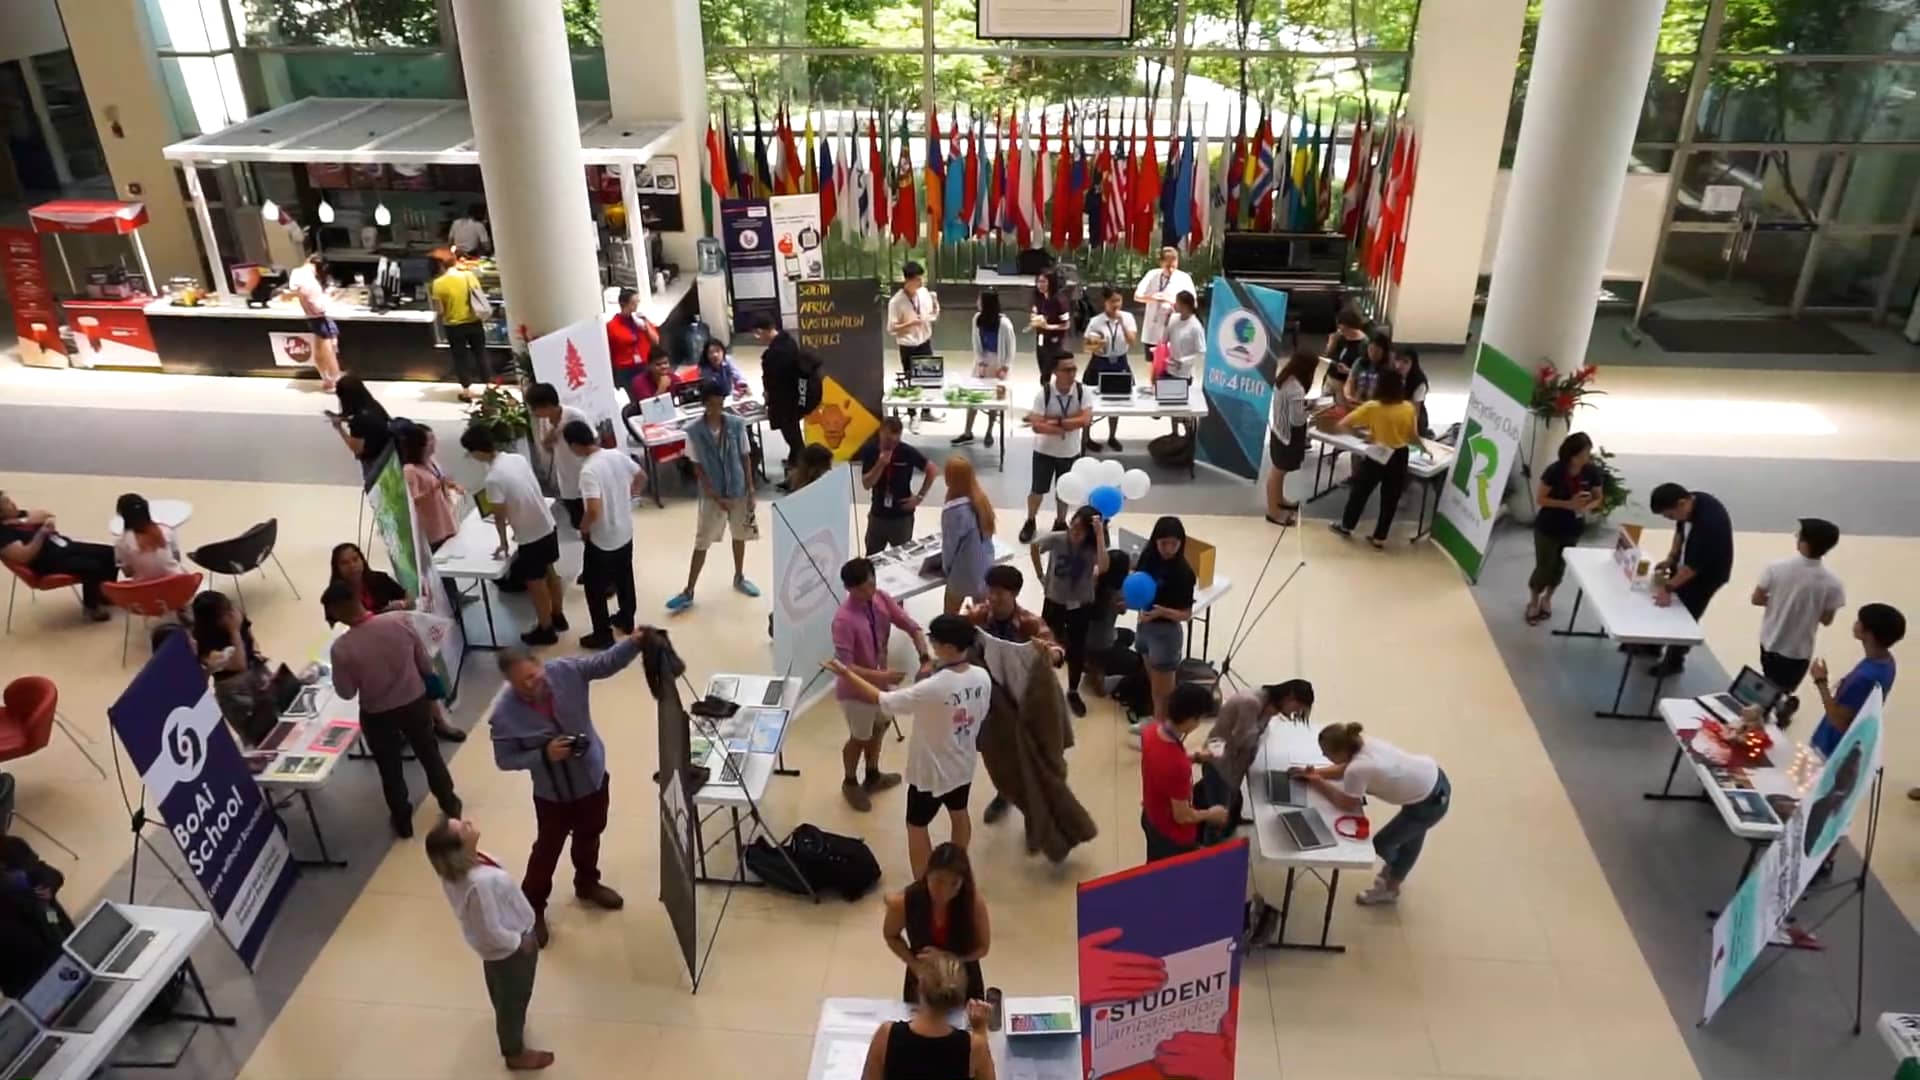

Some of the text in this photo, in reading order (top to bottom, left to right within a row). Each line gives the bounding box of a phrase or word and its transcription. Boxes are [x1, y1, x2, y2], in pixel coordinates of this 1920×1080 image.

[799, 283, 830, 296] SOUTH
[800, 301, 835, 314] AFRICA
[1227, 373, 1239, 390] 4
[173, 782, 215, 850] BoAi
[189, 785, 244, 875] School
[1109, 971, 1227, 1022] STUDENT
[1111, 1000, 1224, 1041] ambassadors
